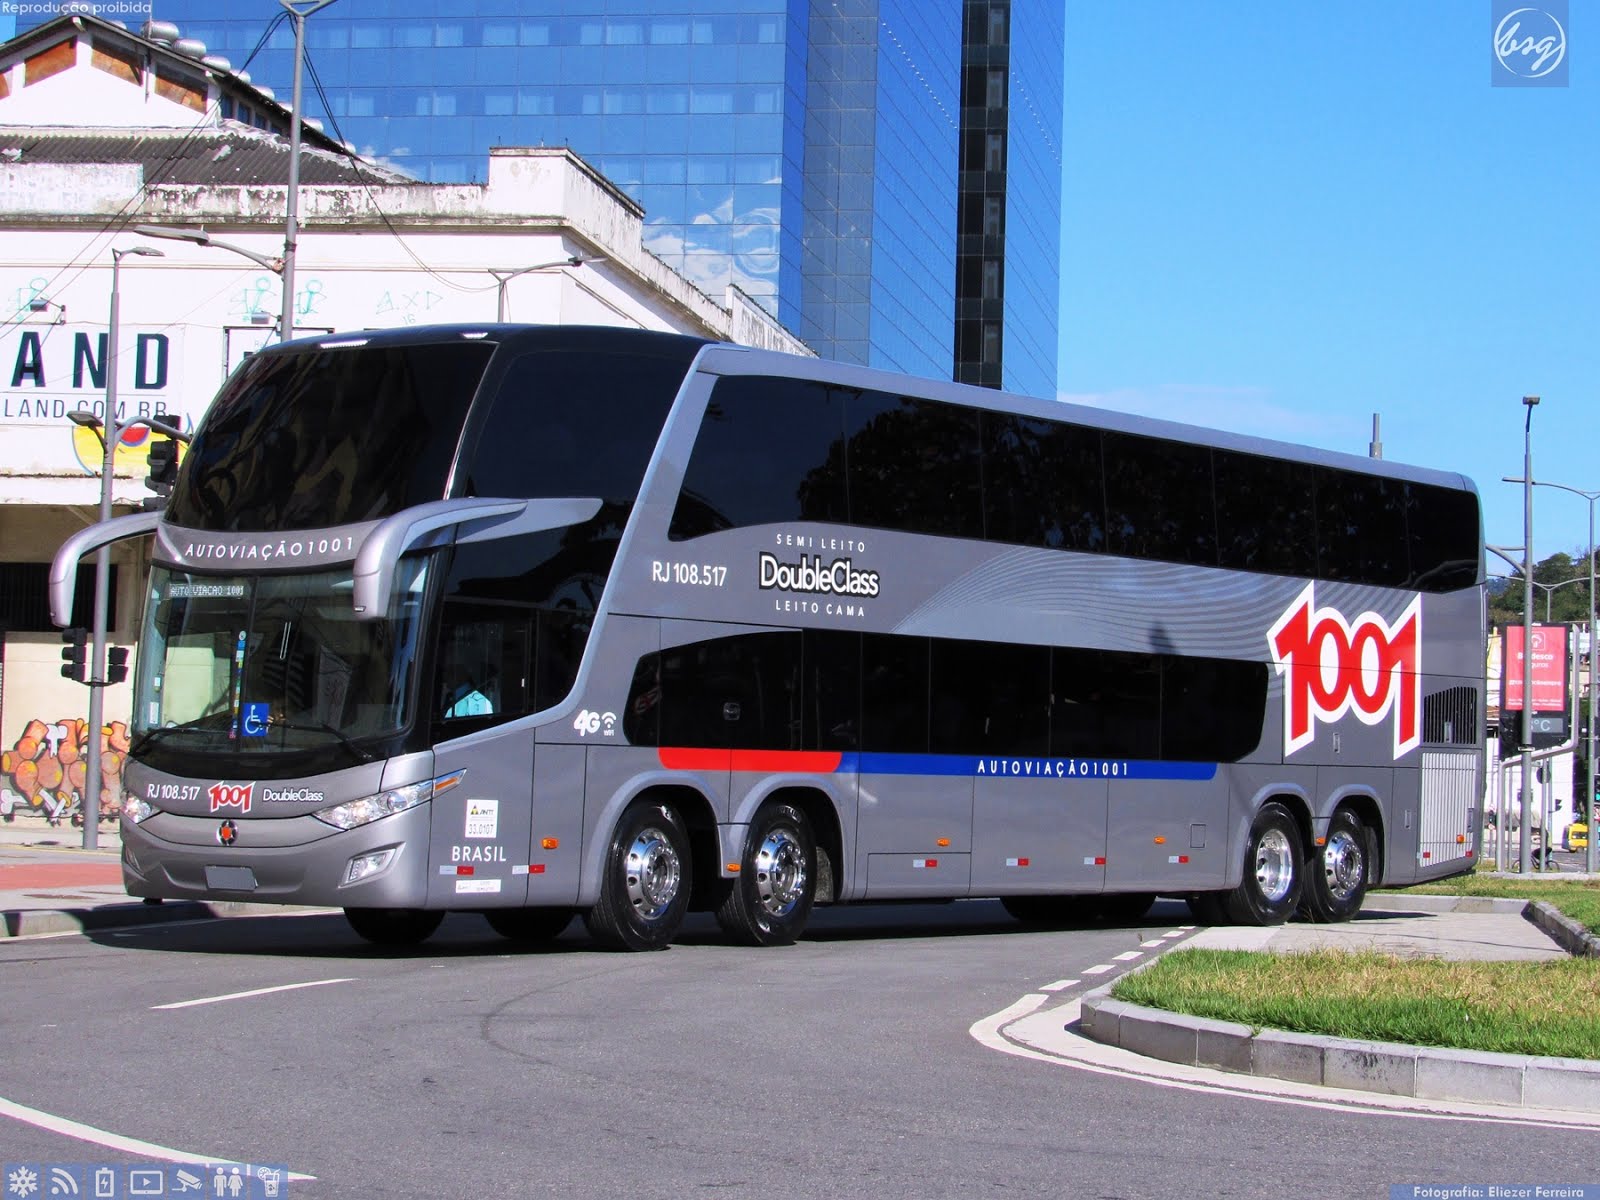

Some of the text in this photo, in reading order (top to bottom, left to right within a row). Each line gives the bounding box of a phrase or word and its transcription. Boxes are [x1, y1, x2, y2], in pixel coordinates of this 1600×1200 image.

[11, 331, 169, 389] AND
[776, 533, 866, 553] SEMI LEITO
[652, 560, 728, 588] RJ 108.517
[758, 551, 880, 597] DoubleClass
[775, 599, 865, 618] LEITO CAMA
[1266, 579, 1422, 761] 1001
[573, 709, 601, 737] 4G
[147, 783, 201, 801] RJ 108.517
[208, 780, 257, 814] 1001
[262, 788, 325, 803] DoubleClass
[451, 846, 507, 862] BRASIL
